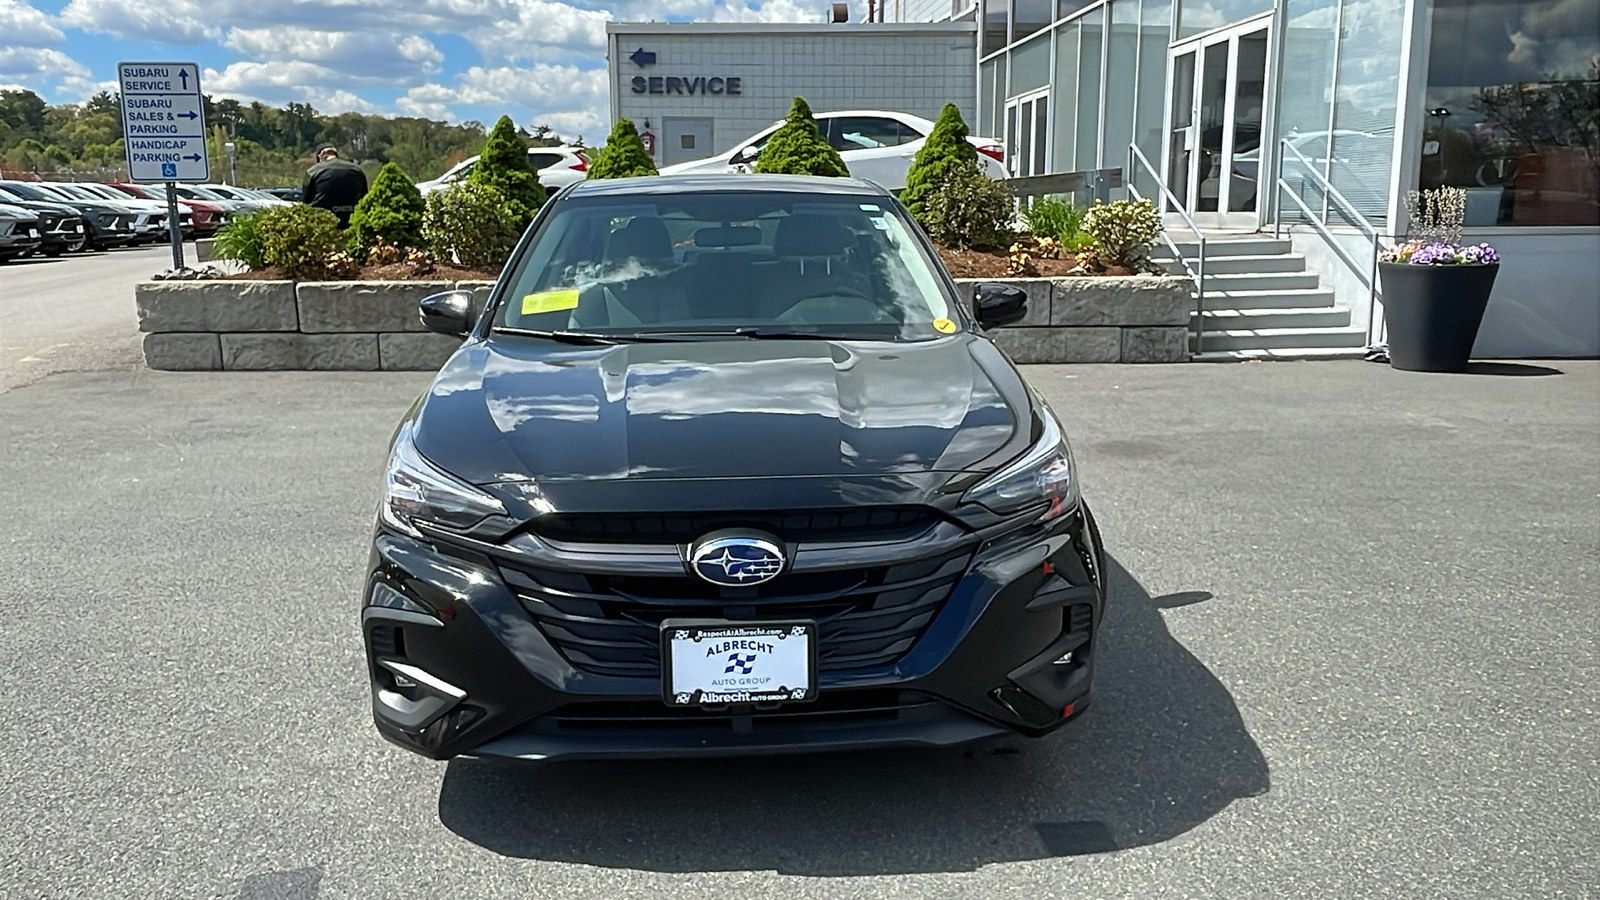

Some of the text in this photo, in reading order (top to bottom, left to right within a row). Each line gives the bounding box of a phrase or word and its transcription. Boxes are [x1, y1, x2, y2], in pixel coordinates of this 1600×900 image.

[123, 68, 169, 78] SUBARU
[125, 81, 171, 91] SERVICE
[631, 76, 741, 96] SERVICE
[127, 99, 172, 109] SUBARU
[128, 112, 174, 121] SALES &
[130, 125, 178, 134] PARKING
[131, 140, 187, 149] HANDICAP
[133, 153, 181, 162] PARKING
[706, 640, 774, 657] ALBRECHT
[711, 677, 771, 686] AUTO GROUP
[699, 691, 751, 703] Albrecht
